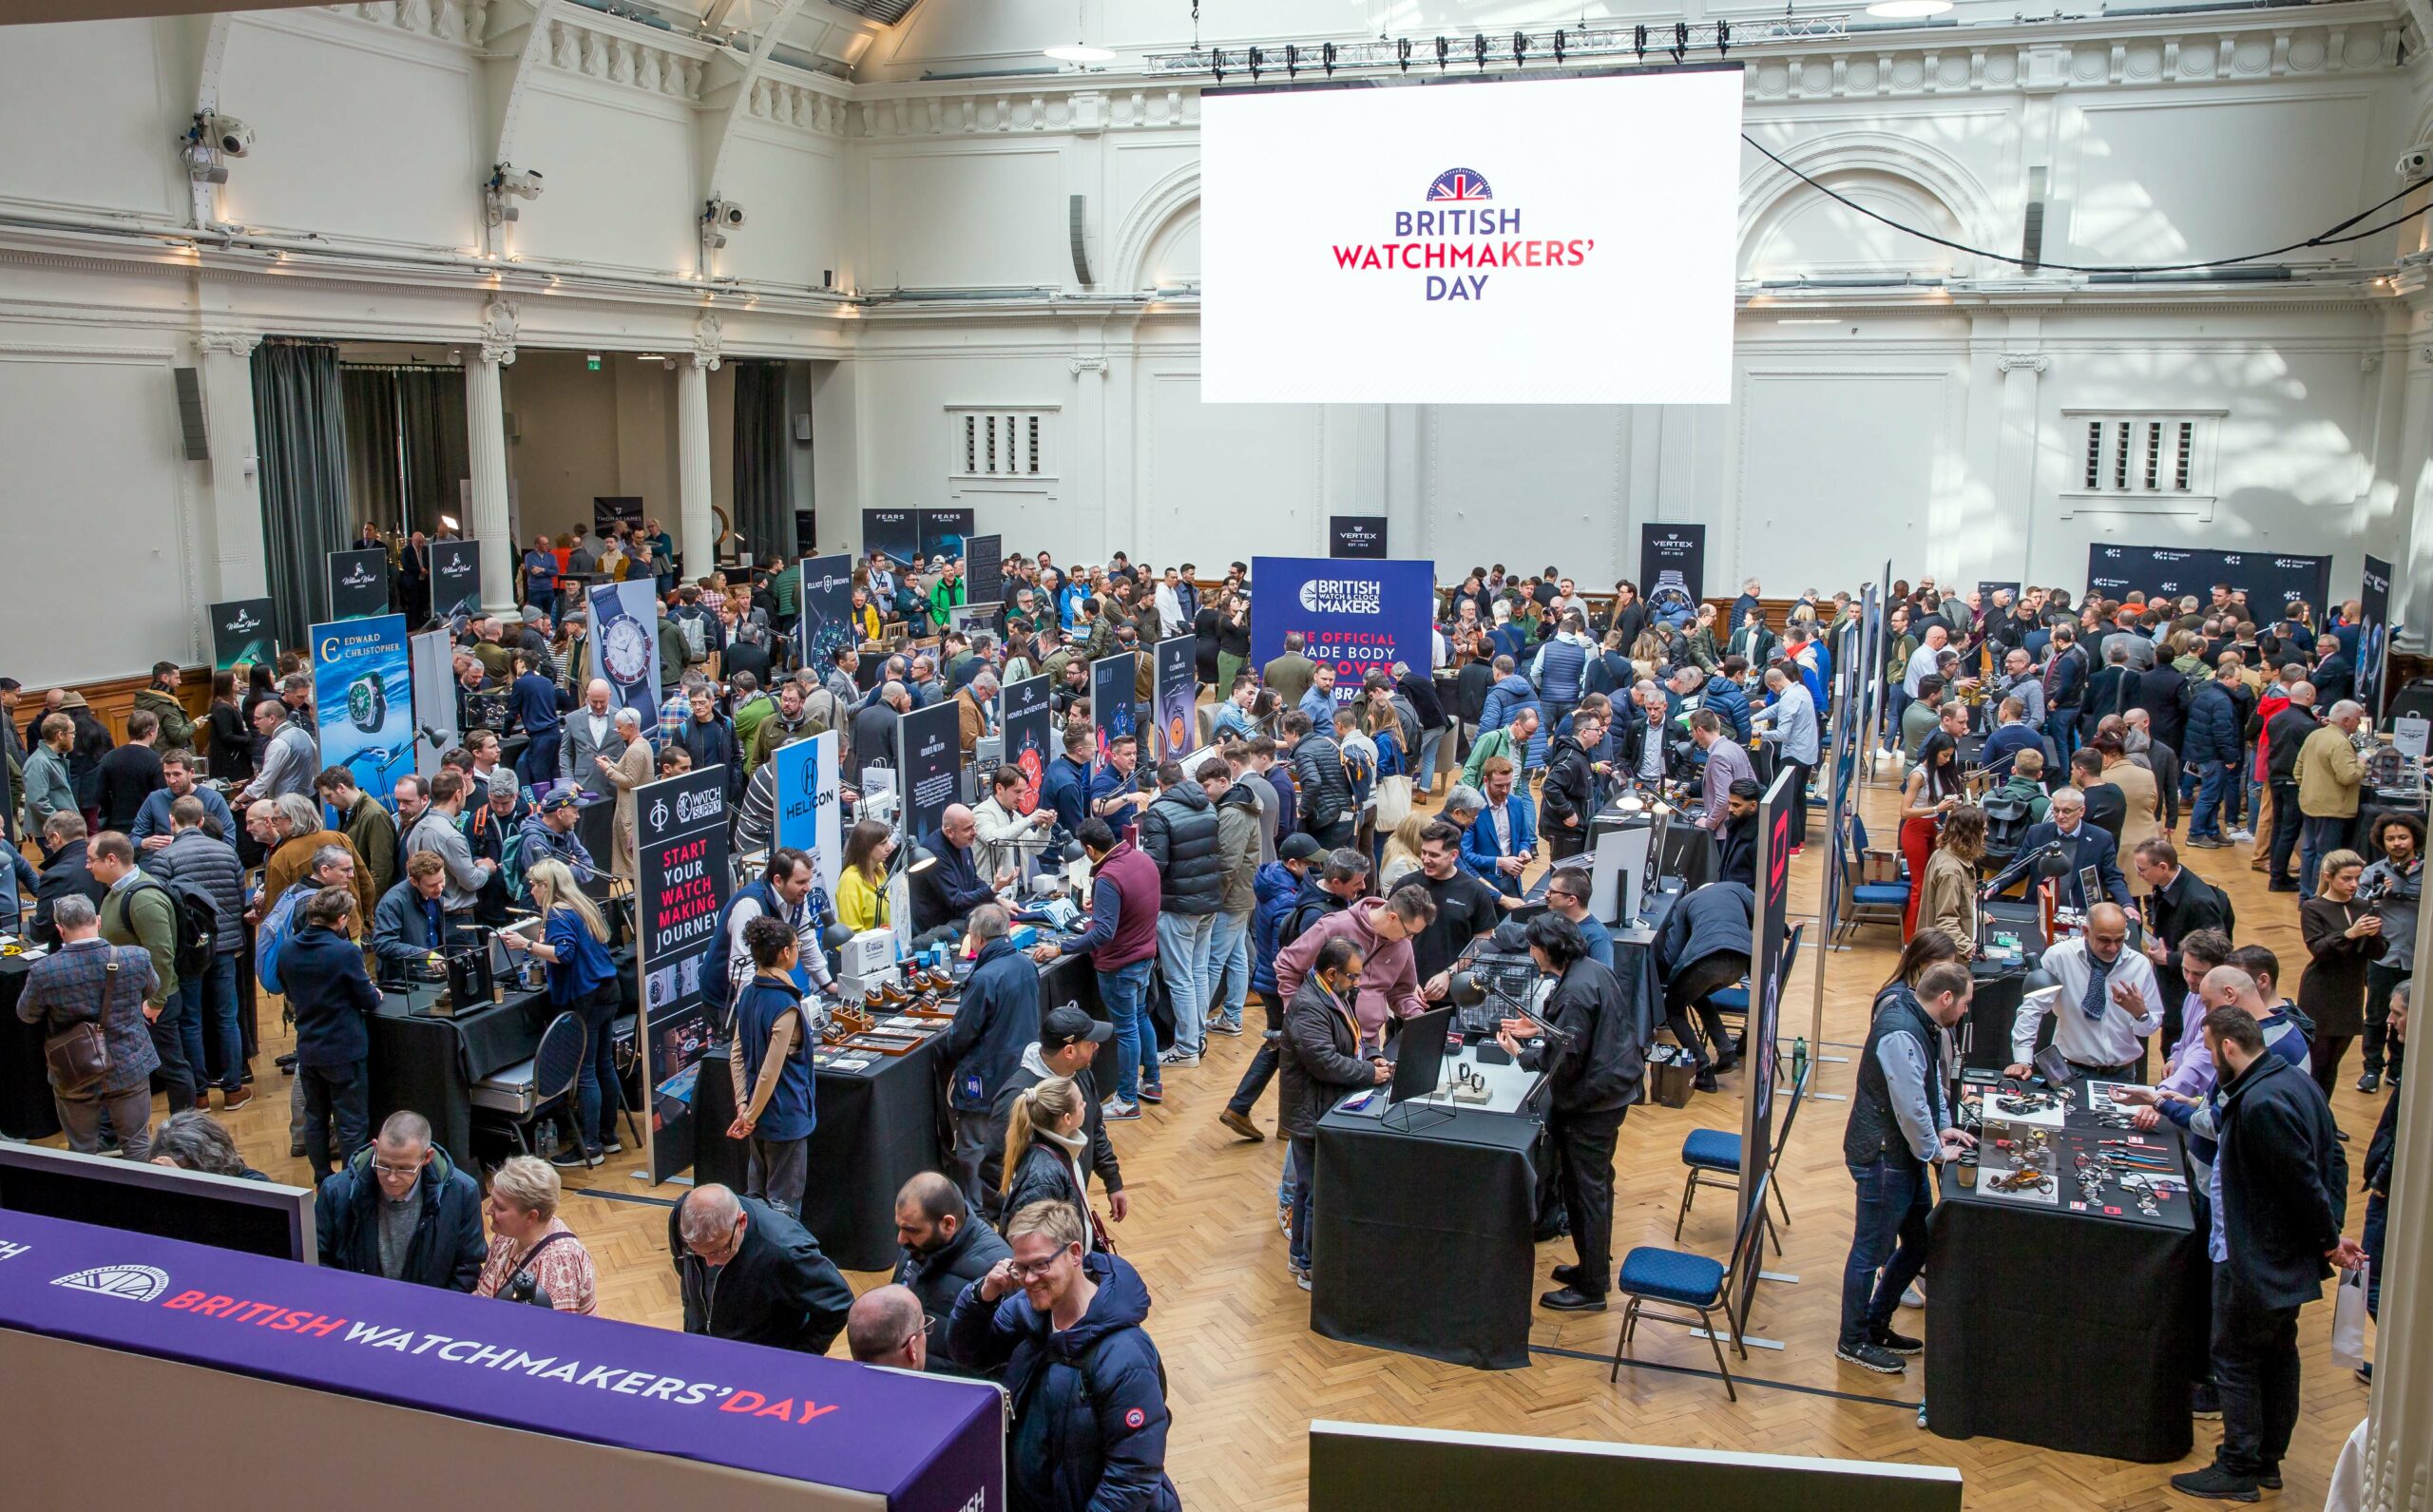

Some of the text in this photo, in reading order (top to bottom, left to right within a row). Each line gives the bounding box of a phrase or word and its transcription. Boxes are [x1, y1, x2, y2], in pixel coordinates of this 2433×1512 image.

[1395, 208, 1521, 237] BRITISH
[1426, 275, 1489, 301] DAY
[1653, 540, 1694, 548] VERTEX
[807, 577, 850, 590] ELLIOT BROWN
[1318, 580, 1380, 595] BRITISH
[1318, 599, 1380, 614] MAKERS
[344, 634, 381, 646] EDWARD
[1321, 632, 1396, 645] OFFICIAL
[345, 642, 401, 659] CHRISTOPHER
[1300, 645, 1395, 660] RADE BODY
[1023, 700, 1048, 716] ADVENTURE
[692, 786, 721, 807] WATCH
[694, 800, 720, 818] SUPPLY
[662, 839, 707, 868] START
[663, 860, 703, 887] YOUR
[661, 875, 712, 907] WATCH
[659, 893, 717, 928] MAKING
[656, 910, 719, 954] JOURNEY
[162, 1290, 347, 1338] BRITISH
[718, 1389, 839, 1425] DAY
